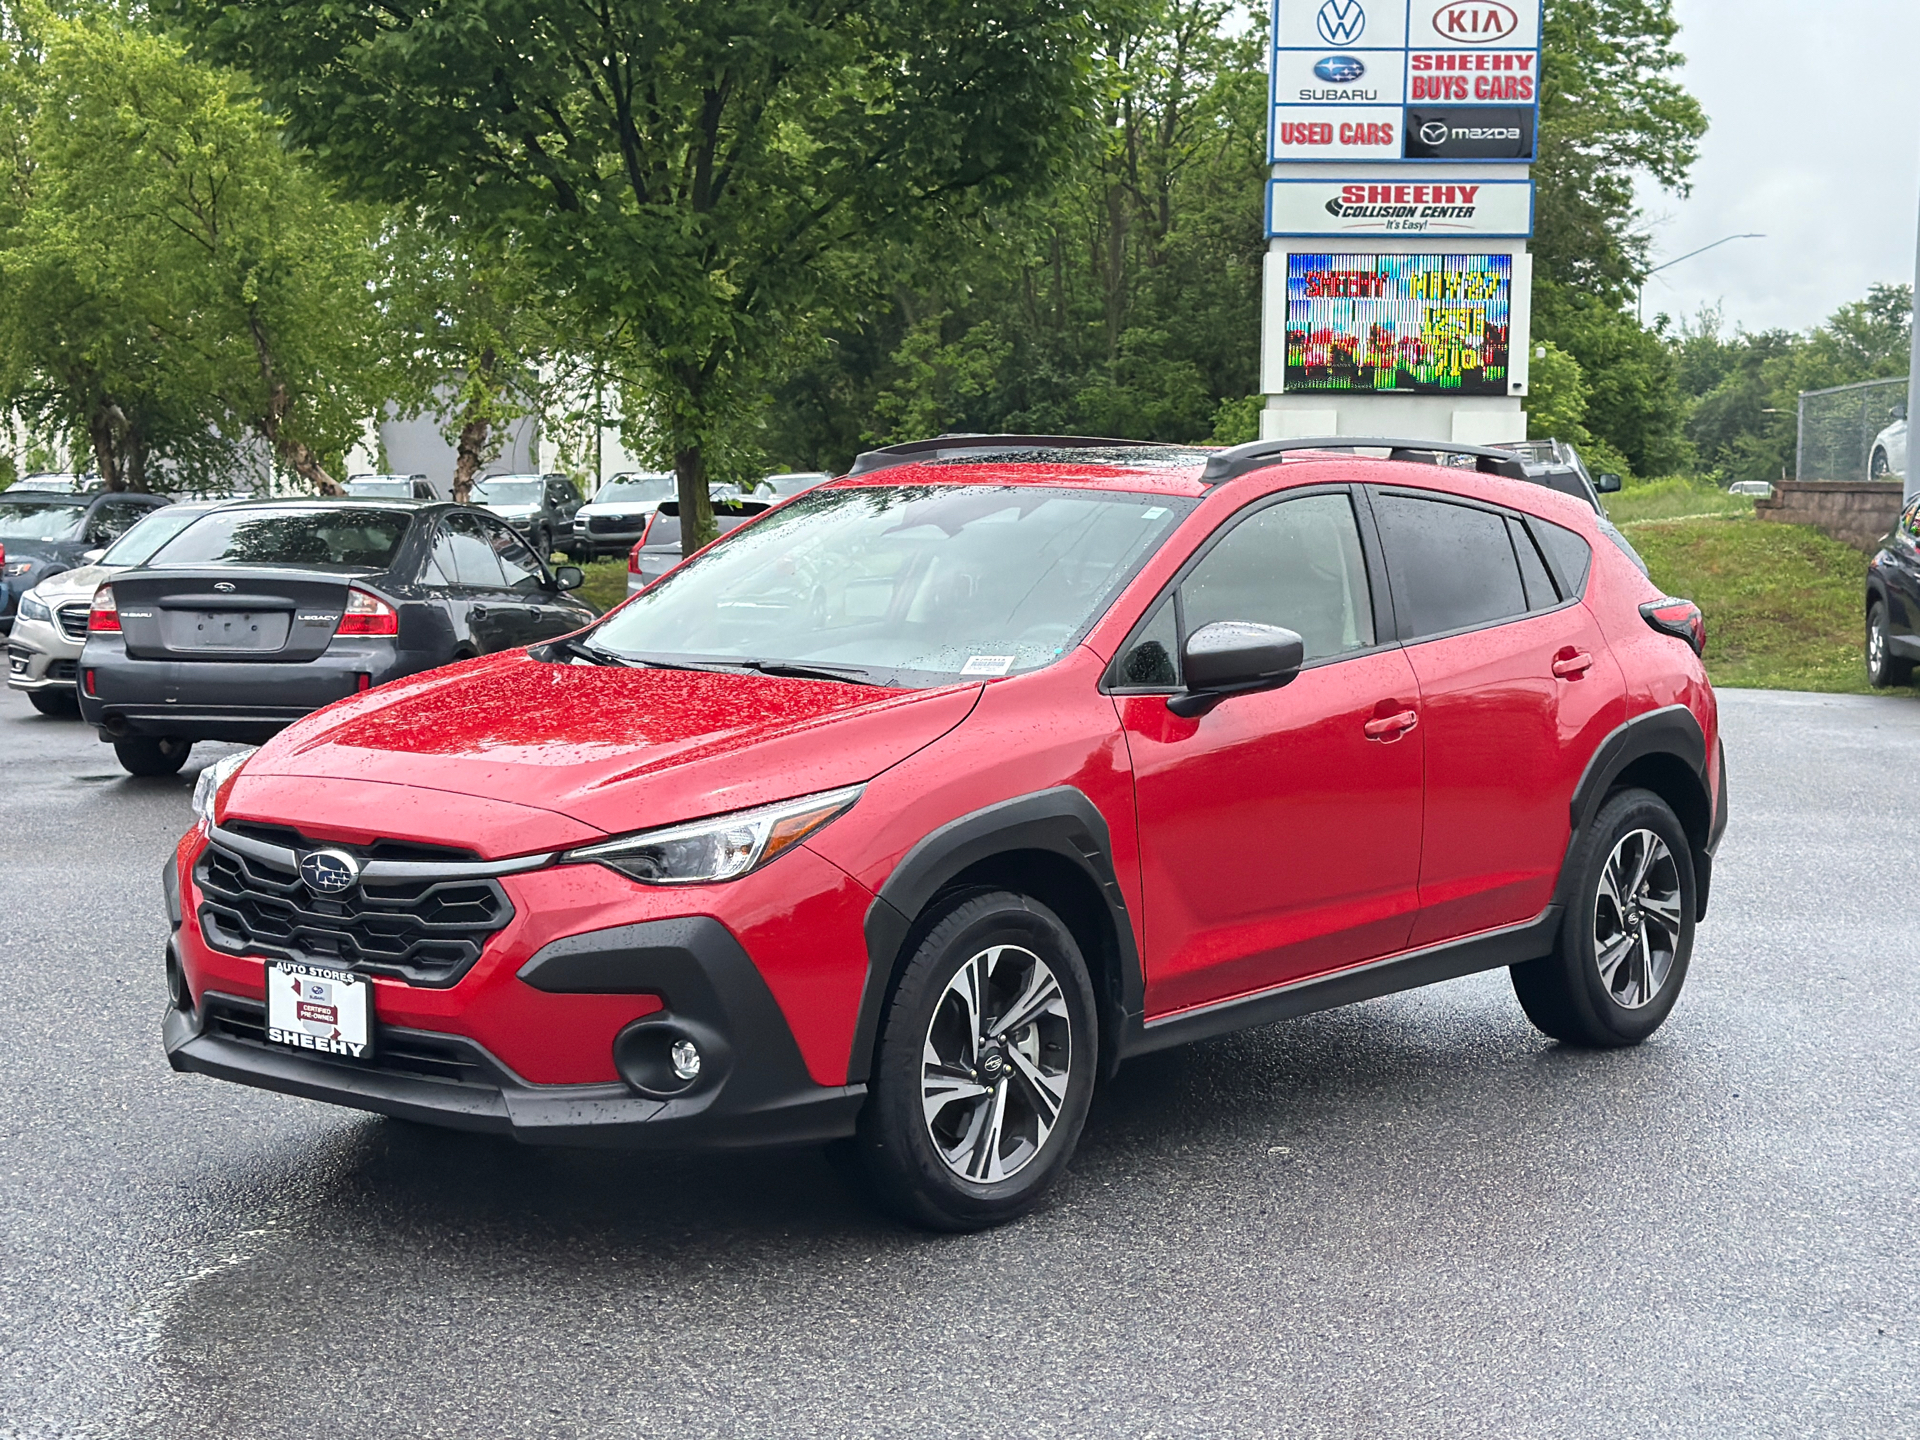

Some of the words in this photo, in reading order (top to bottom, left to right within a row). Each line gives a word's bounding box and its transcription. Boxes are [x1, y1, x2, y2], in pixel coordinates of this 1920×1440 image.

[1448, 10, 1503, 33] KIA
[1411, 54, 1534, 71] SHEEHY
[1299, 89, 1377, 101] SUBARU
[1411, 75, 1468, 100] BUYS
[1474, 75, 1533, 100] CARS
[1280, 122, 1333, 145] USED
[1339, 122, 1393, 146] CARS
[1341, 185, 1480, 204] SHEEHY
[1341, 205, 1418, 218] COLLISION
[1419, 206, 1476, 218] CENTER
[1386, 220, 1400, 230] It's
[1402, 220, 1428, 231] Easy!
[1305, 270, 1389, 298] SHEEHY
[276, 962, 306, 974] AUTO
[309, 967, 355, 983] STORES
[300, 1010, 334, 1022] PRE-OWNED
[303, 1004, 331, 1015] CERTIFIED
[268, 1028, 365, 1058] SHEEHY
